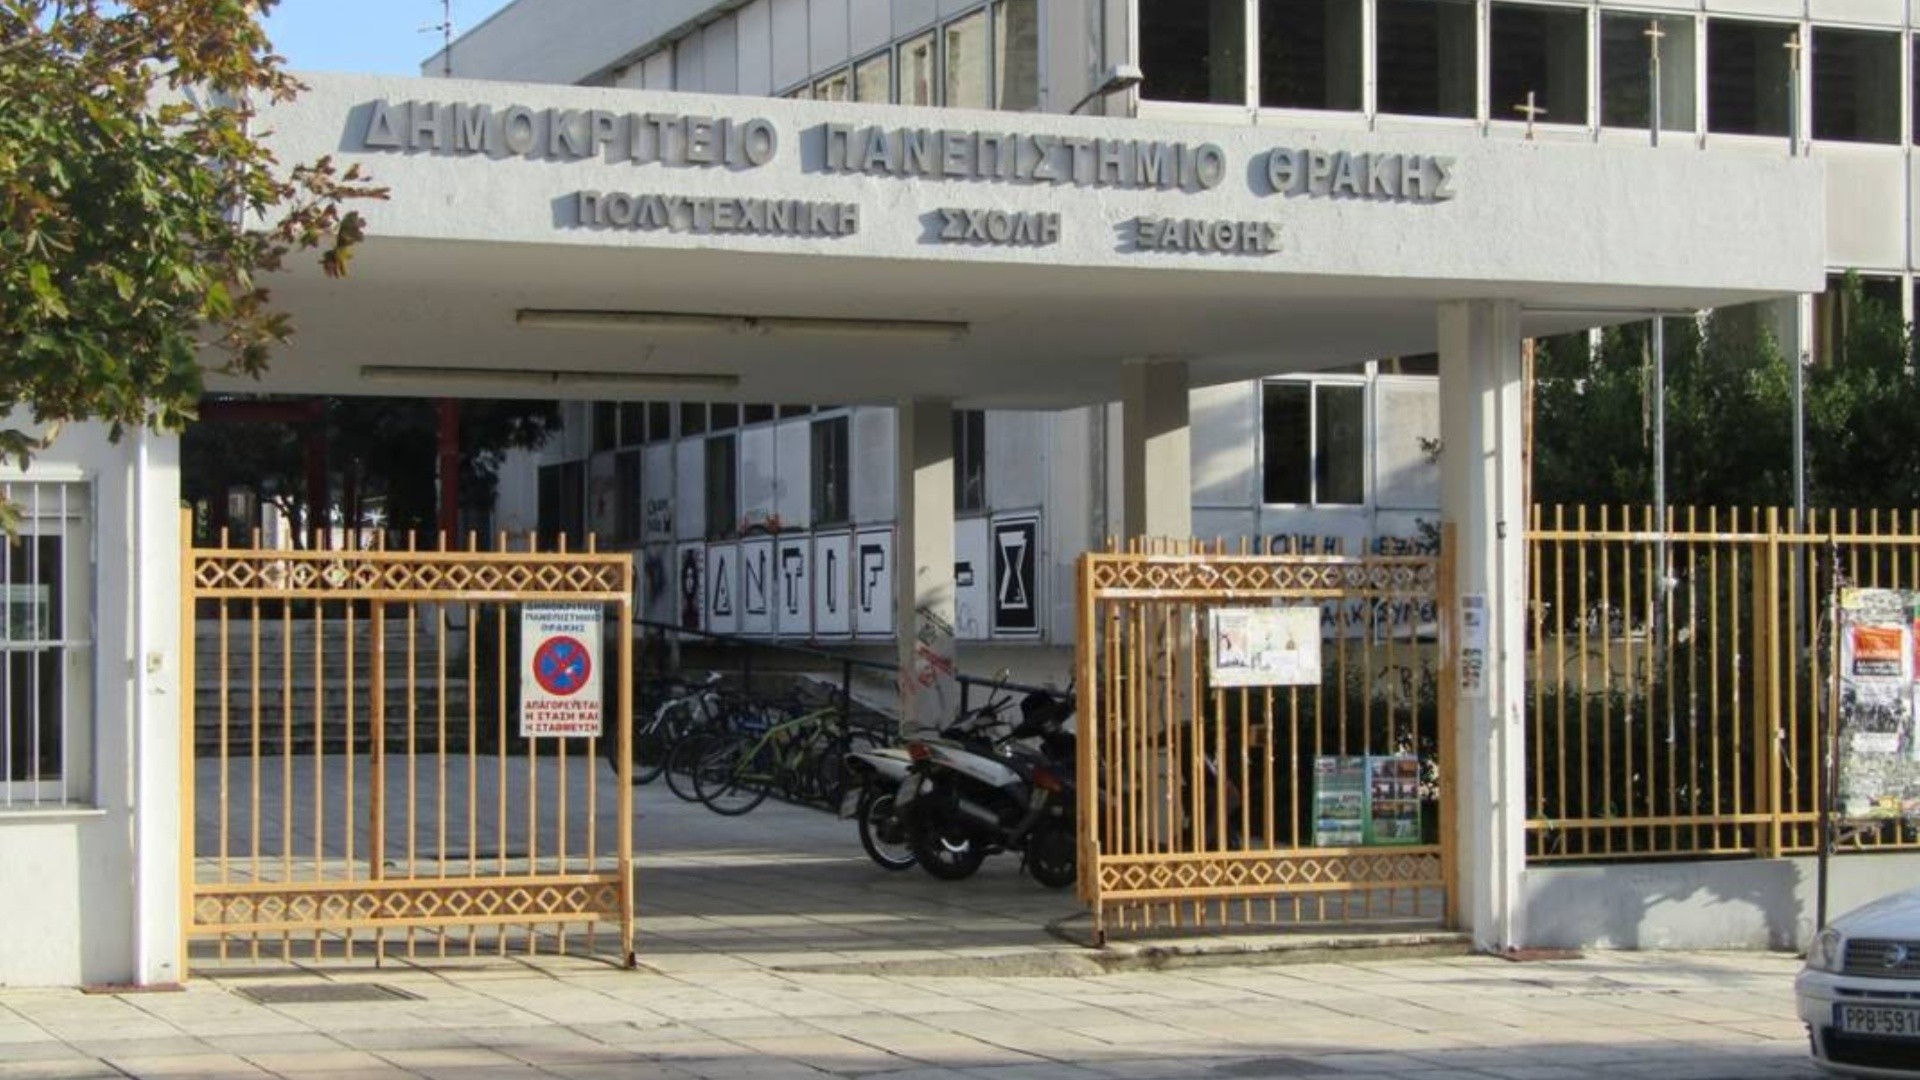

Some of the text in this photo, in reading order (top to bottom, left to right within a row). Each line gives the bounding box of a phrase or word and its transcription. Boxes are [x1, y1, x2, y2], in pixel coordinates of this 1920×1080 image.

[364, 99, 1457, 200] ΔΗΜΟΚΡΙΤΕΙΟ ΠΑΝΕΠΙΣΤΗΜΙΟ ΘΡΑΚΗΣ
[577, 190, 1285, 253] ΠΟΛΥΤΕΧΝΙΚΗ ΣΧΟΛΗ ΞΑΝΘΗΣ
